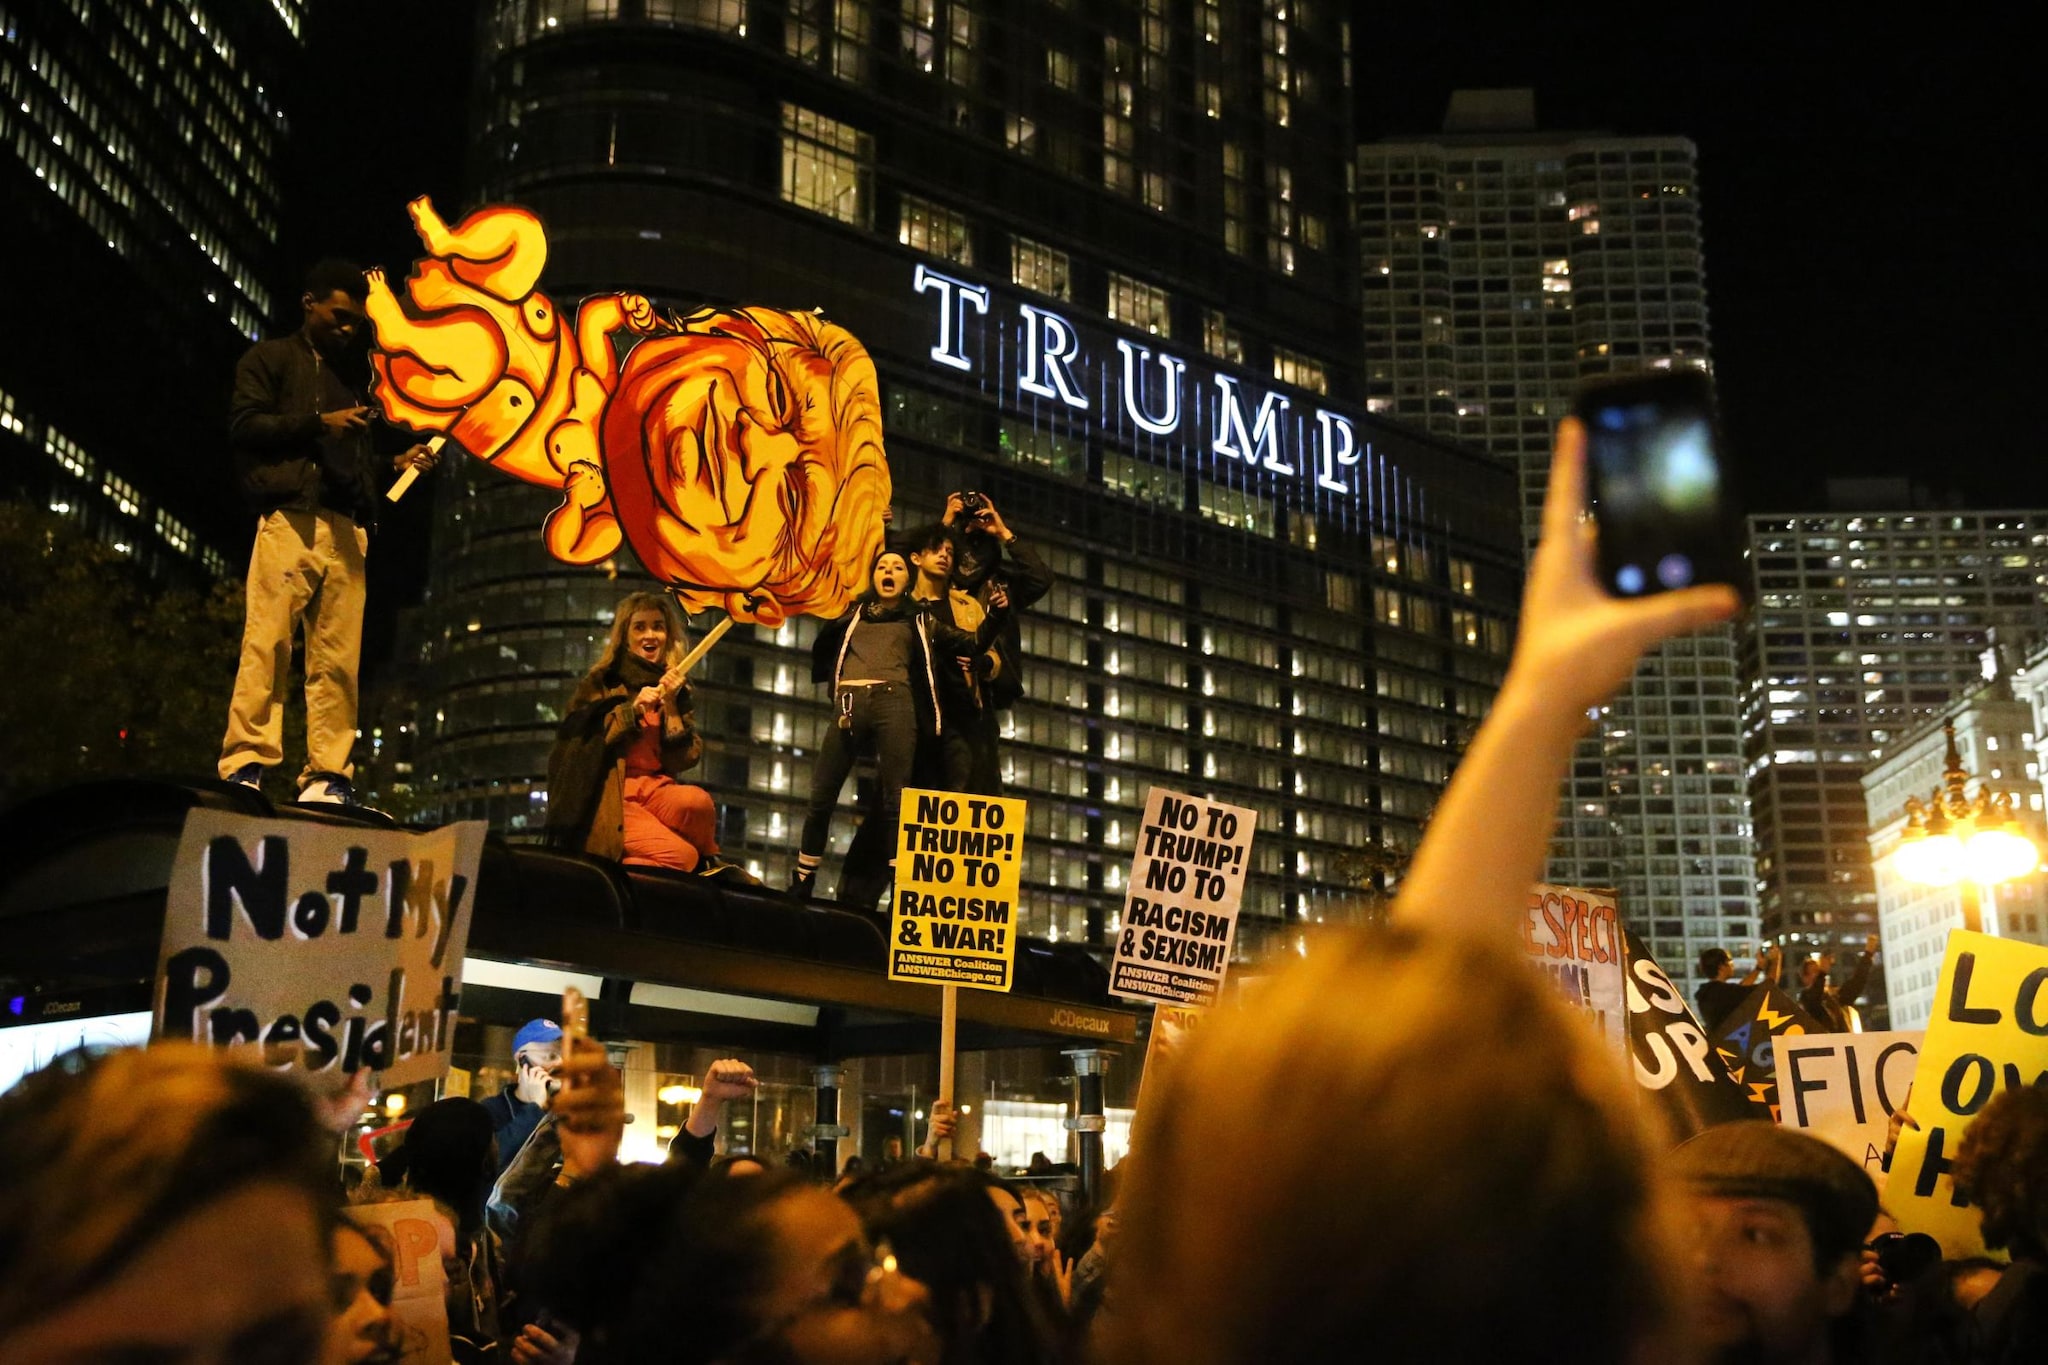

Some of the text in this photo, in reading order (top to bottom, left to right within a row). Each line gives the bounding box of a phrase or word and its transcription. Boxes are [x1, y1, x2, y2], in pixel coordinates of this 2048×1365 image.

[914, 263, 1361, 494] TRUMP
[917, 795, 1005, 829] NO TO
[1158, 796, 1237, 840] NO TO
[903, 823, 1014, 861] TRUMP!
[1144, 825, 1244, 875] TRUMP!
[912, 853, 1000, 888] NO TO
[1145, 858, 1226, 902] NO TO
[203, 834, 467, 970] Not My
[899, 890, 1009, 924] RACISM
[1127, 896, 1230, 942] RACISM
[898, 919, 1005, 954] & WAR!
[1120, 928, 1226, 974] & SEXISM!
[1524, 892, 1617, 966] ESPECT
[897, 964, 1002, 985] ANSWERChicago.org
[898, 953, 1003, 972] ANSWER Coalition
[1119, 966, 1215, 993] ANSWER Coalition
[162, 946, 459, 1072] President
[1050, 1008, 1110, 1033] JCDecaux
[1633, 1021, 1715, 1090] UP
